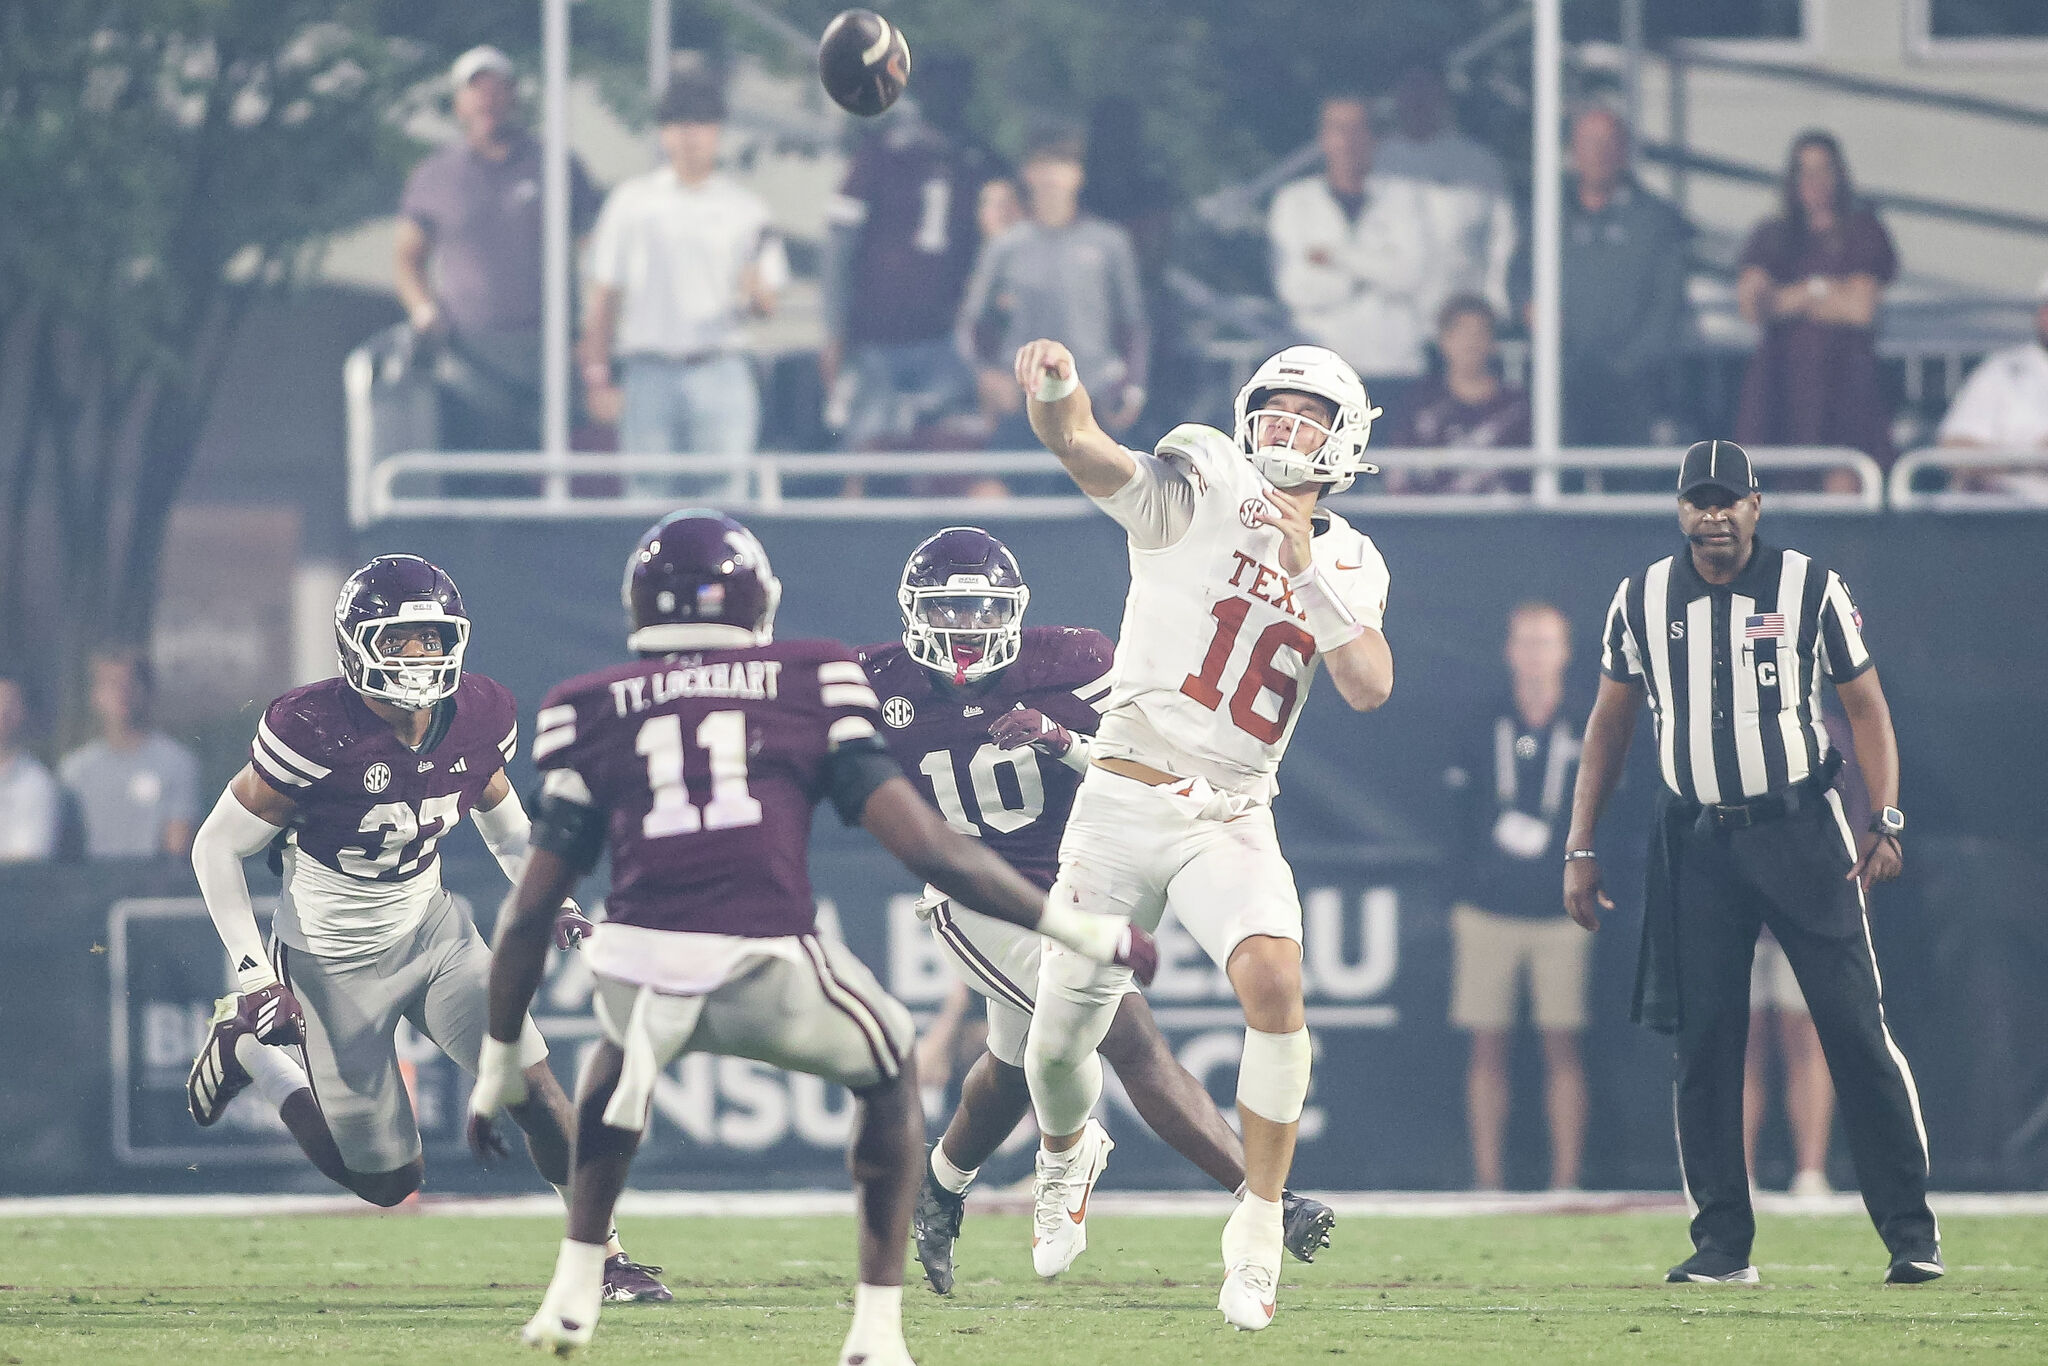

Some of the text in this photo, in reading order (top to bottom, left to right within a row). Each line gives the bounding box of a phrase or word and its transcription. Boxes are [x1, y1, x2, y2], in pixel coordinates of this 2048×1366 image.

[1229, 549, 1307, 622] TEX
[1669, 620, 1685, 639] S
[651, 660, 783, 706] LOCKHART
[1179, 595, 1317, 745] 16
[1757, 661, 1777, 687] C
[885, 699, 912, 726] SEC
[365, 764, 390, 792] SEC
[634, 709, 763, 840] 11
[918, 742, 1045, 838] 10
[336, 790, 462, 879] 37
